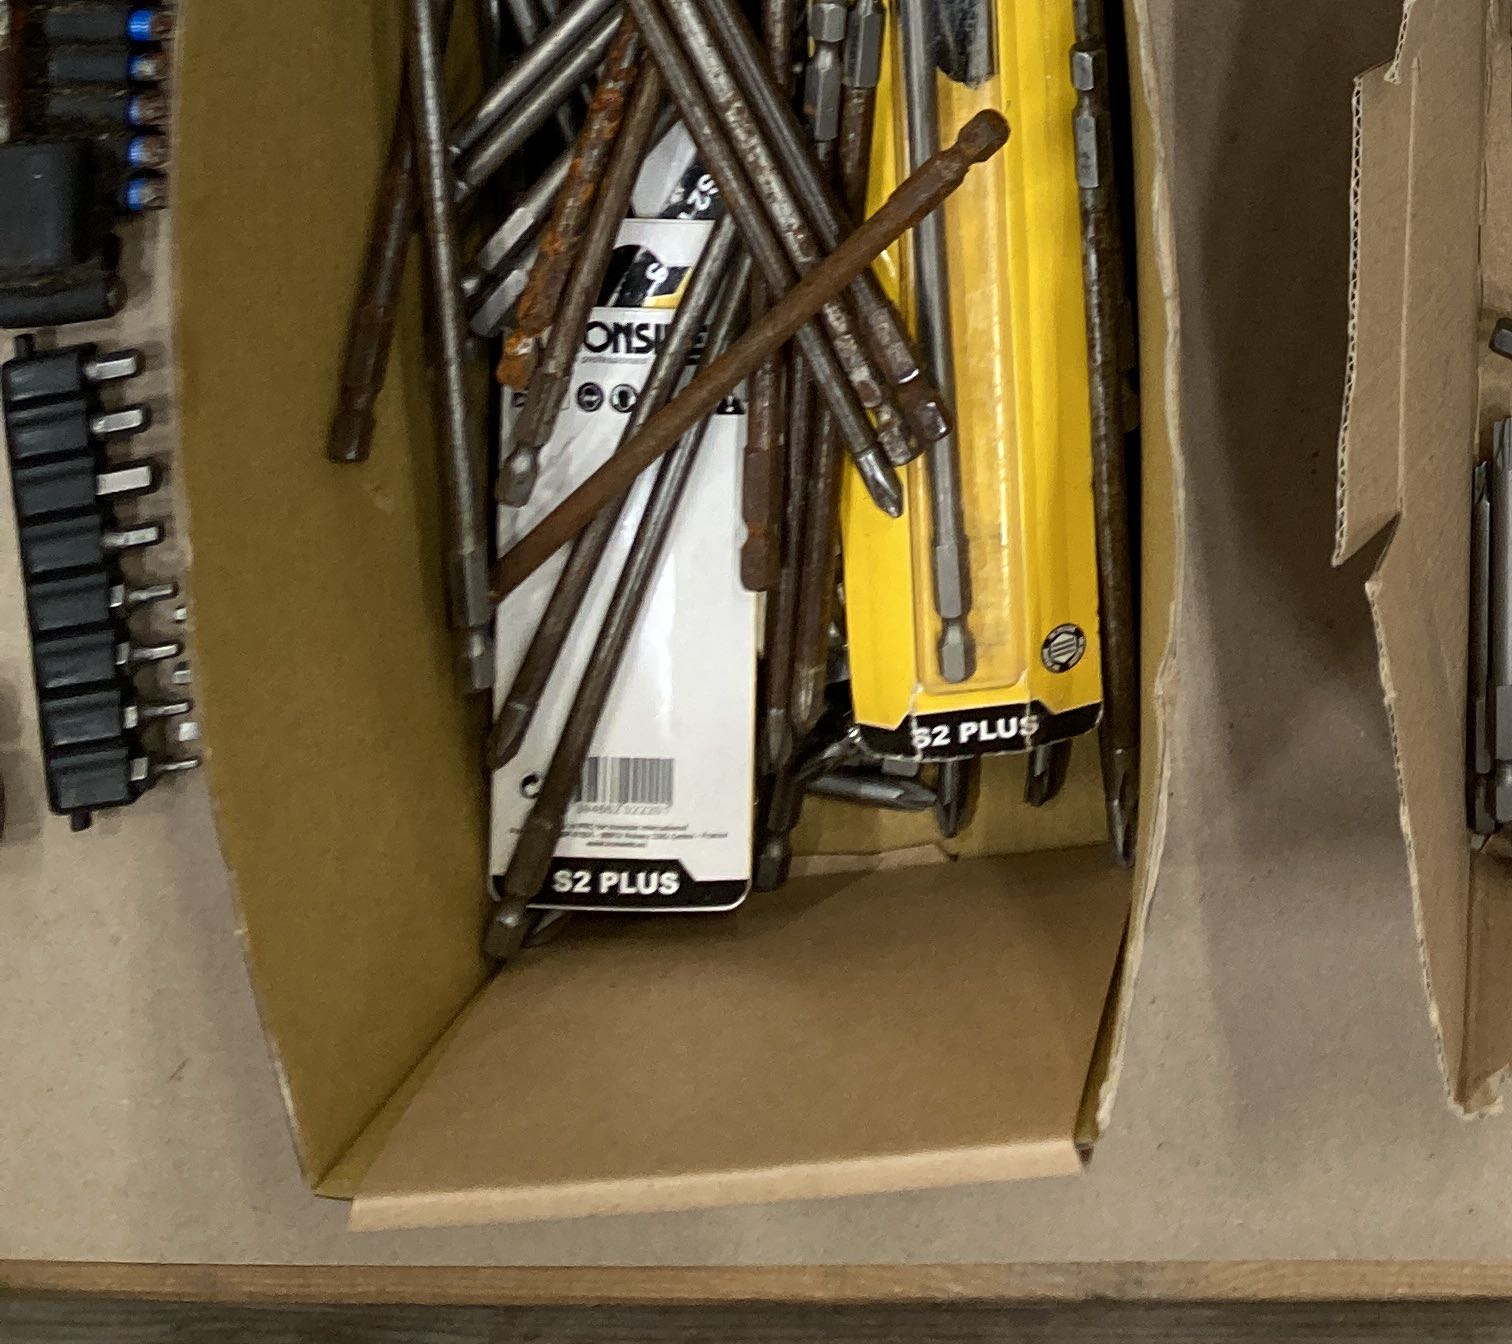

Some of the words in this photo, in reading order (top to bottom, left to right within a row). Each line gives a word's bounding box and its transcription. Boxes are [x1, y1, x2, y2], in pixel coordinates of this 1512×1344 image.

[912, 724, 951, 749] S2
[959, 716, 1038, 744] PLUS
[552, 870, 591, 893] S2
[599, 871, 681, 895] PLUS
